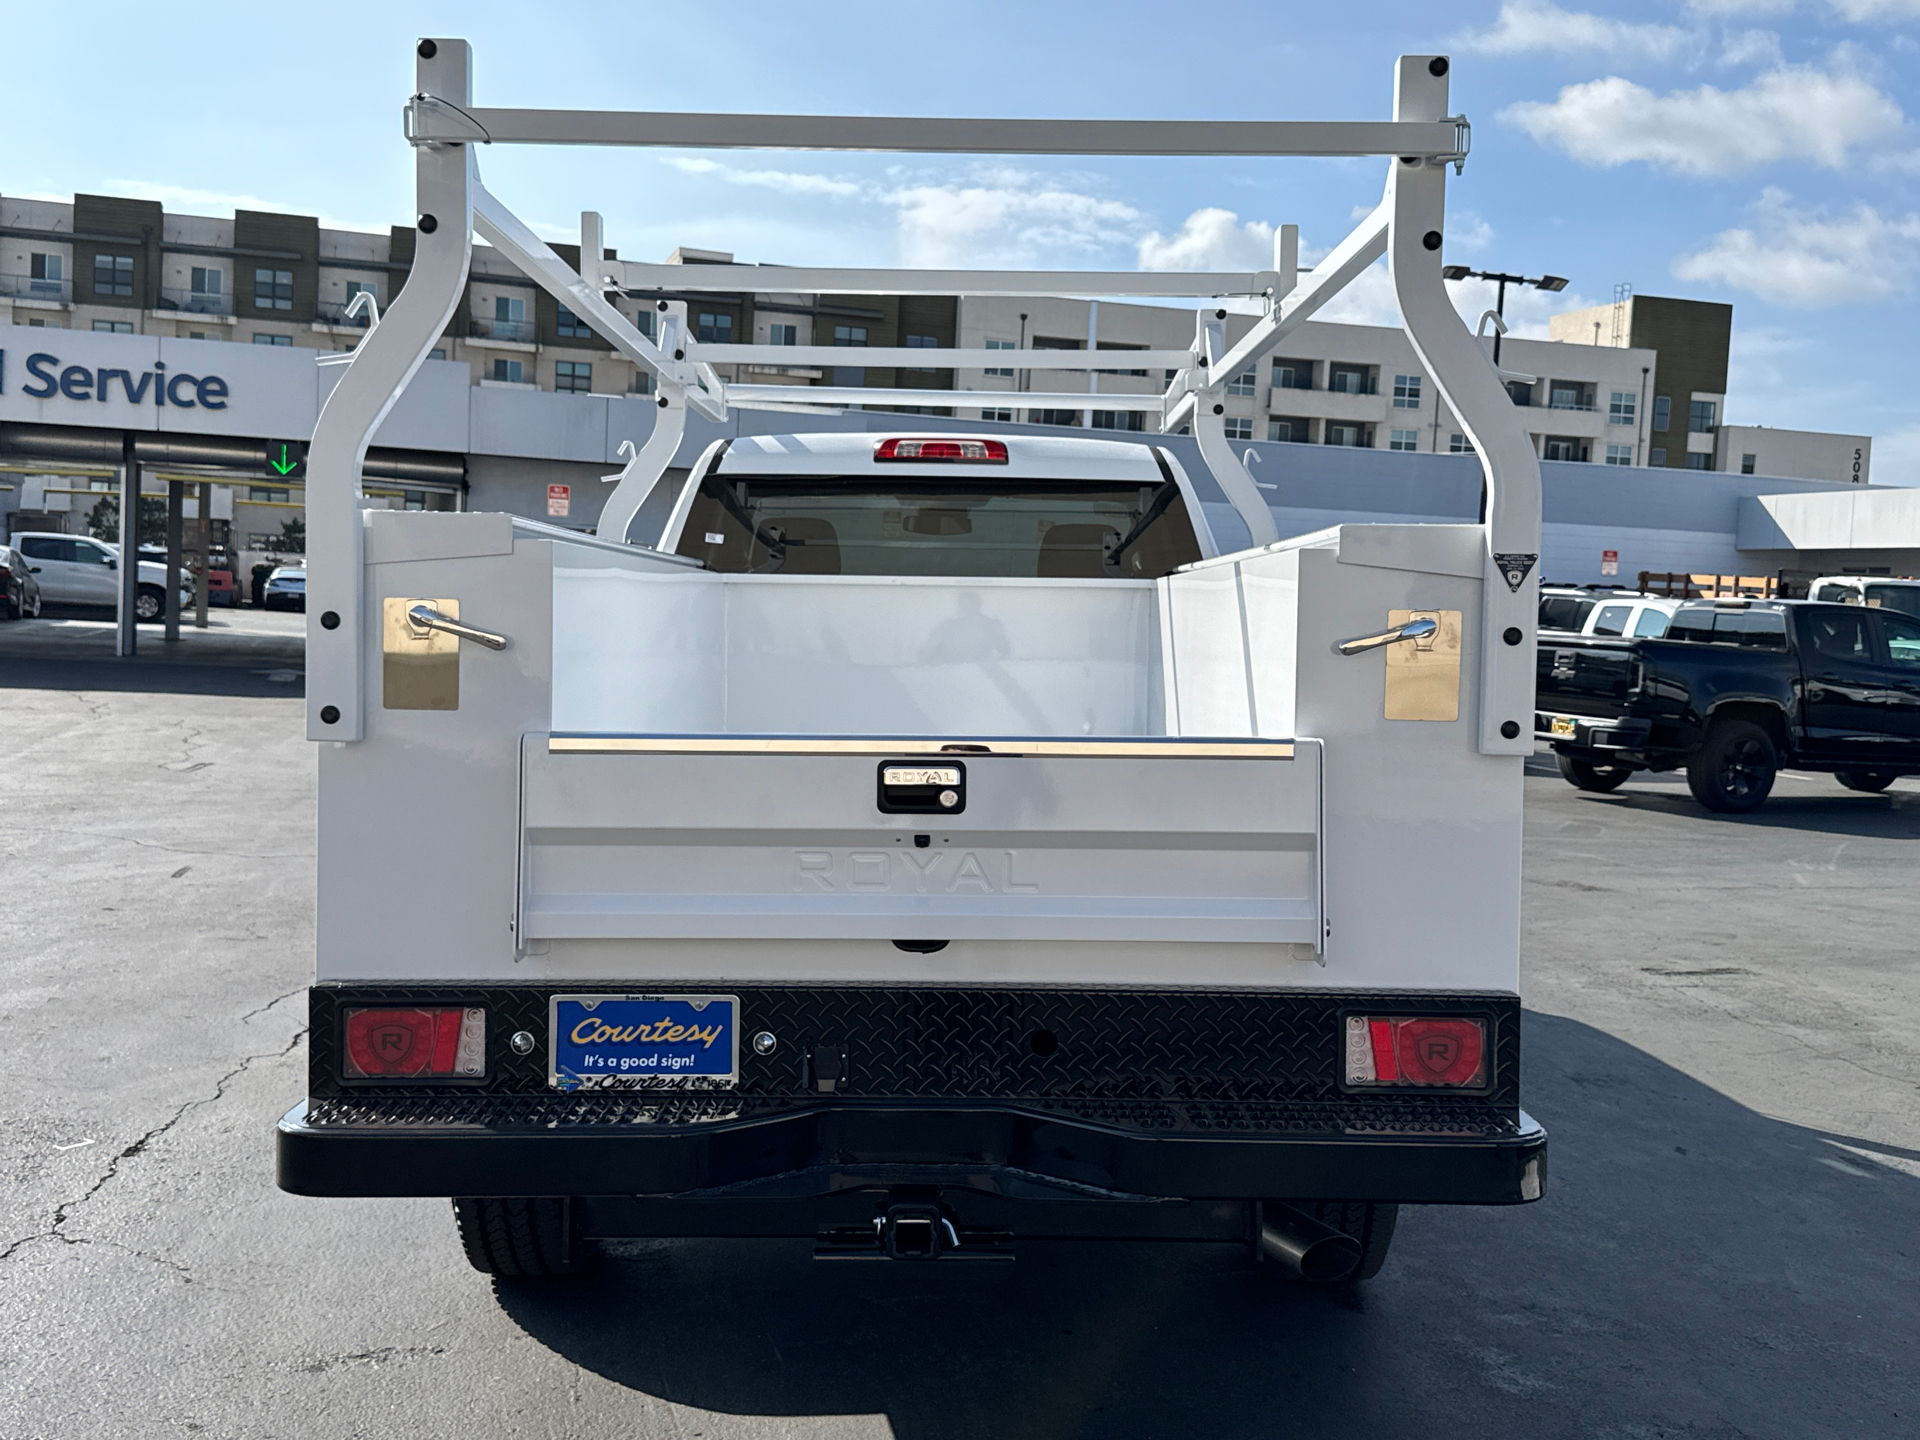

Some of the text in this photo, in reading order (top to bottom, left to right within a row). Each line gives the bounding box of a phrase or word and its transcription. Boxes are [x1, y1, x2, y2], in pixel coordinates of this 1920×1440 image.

[22, 353, 229, 410] Service
[889, 771, 954, 783] ROYAL
[793, 851, 1039, 893] ROYAL
[381, 1033, 402, 1051] R
[571, 1016, 723, 1049] Courtesy
[1428, 1043, 1449, 1061] R
[584, 1054, 695, 1070] It's a good sign!
[600, 1072, 688, 1092] Courtesy
